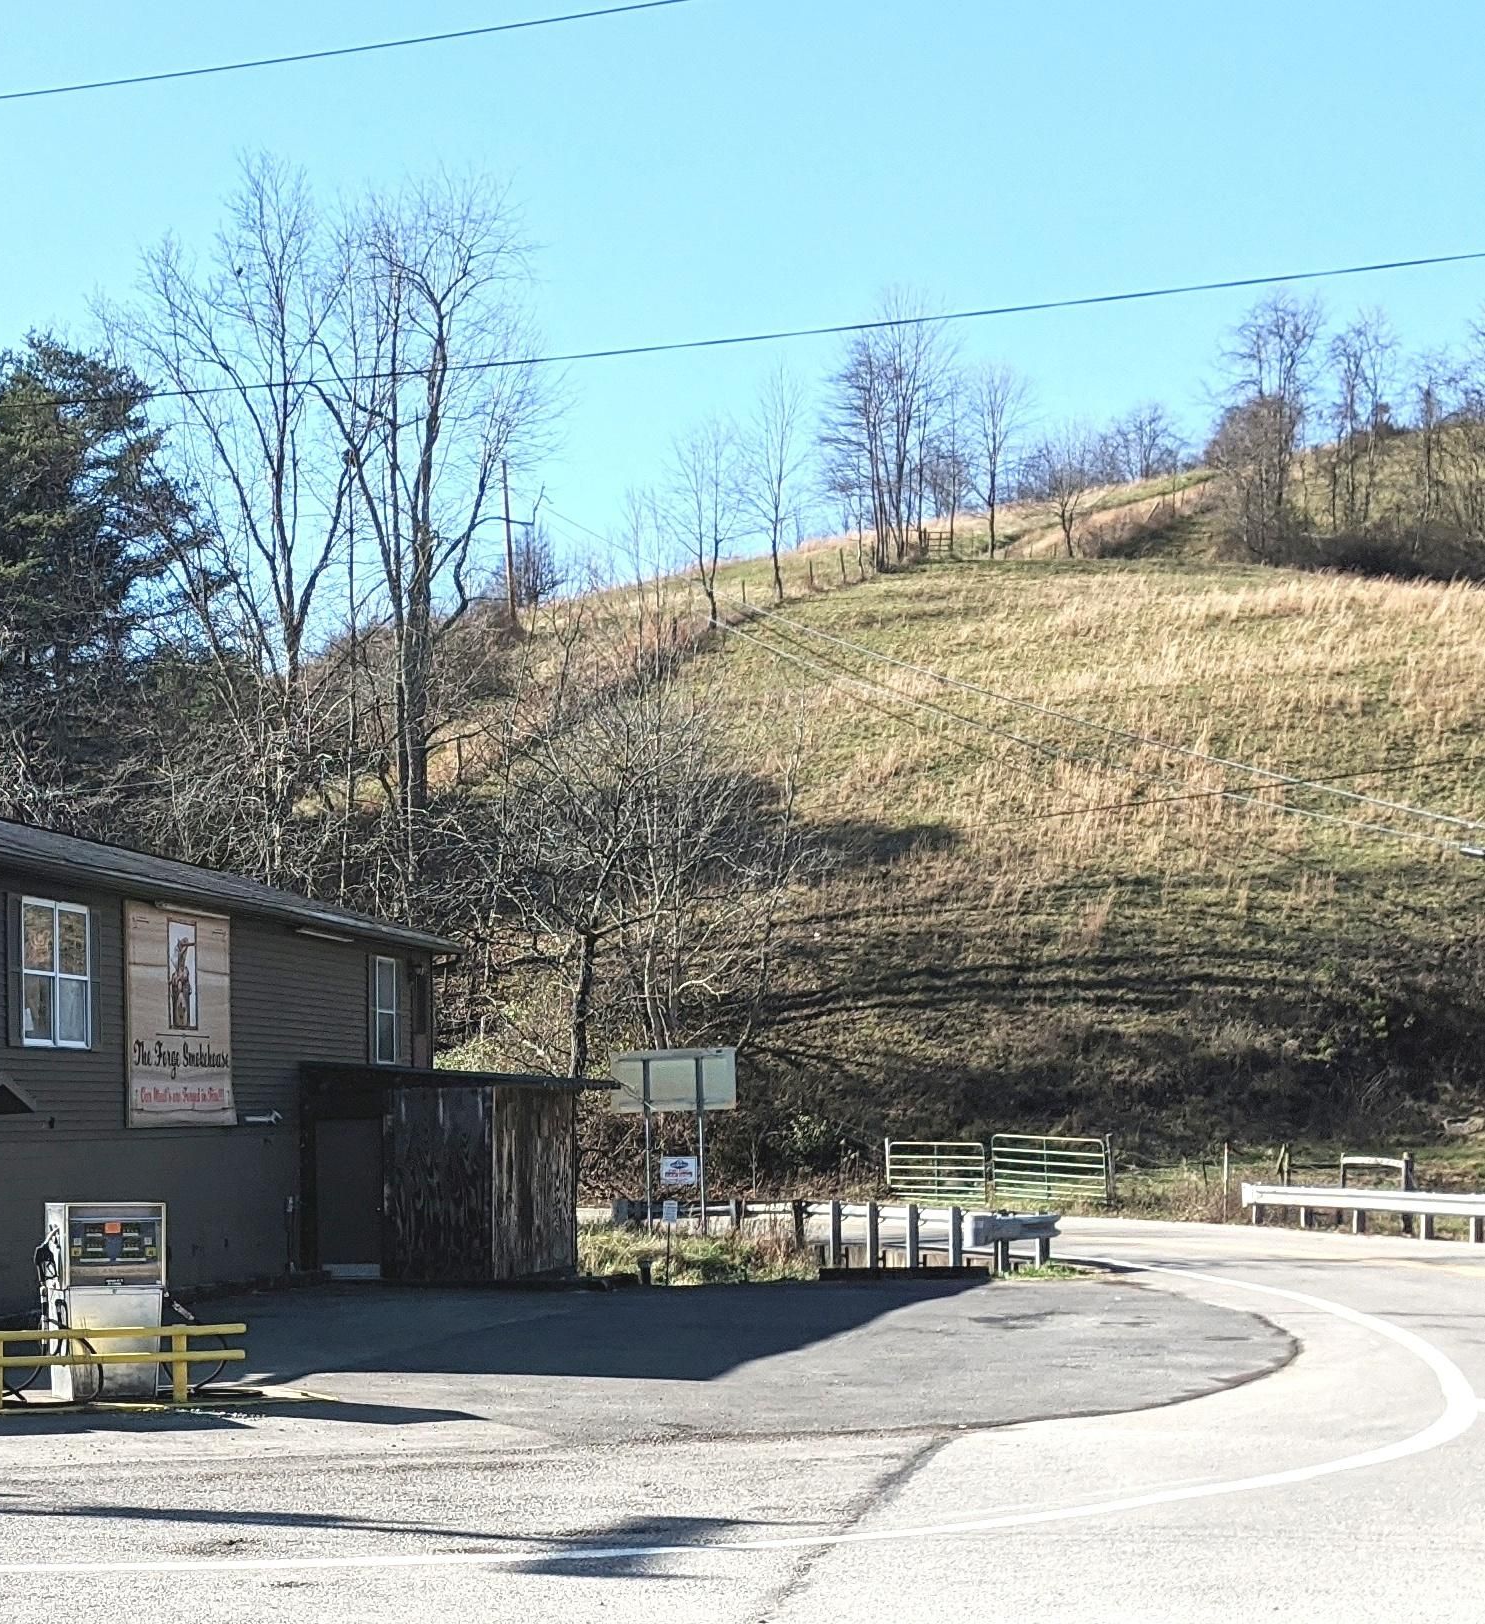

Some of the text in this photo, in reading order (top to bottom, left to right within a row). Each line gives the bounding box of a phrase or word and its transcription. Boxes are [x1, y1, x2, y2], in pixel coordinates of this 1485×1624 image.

[133, 1040, 229, 1080] The Forge Smokehouse
